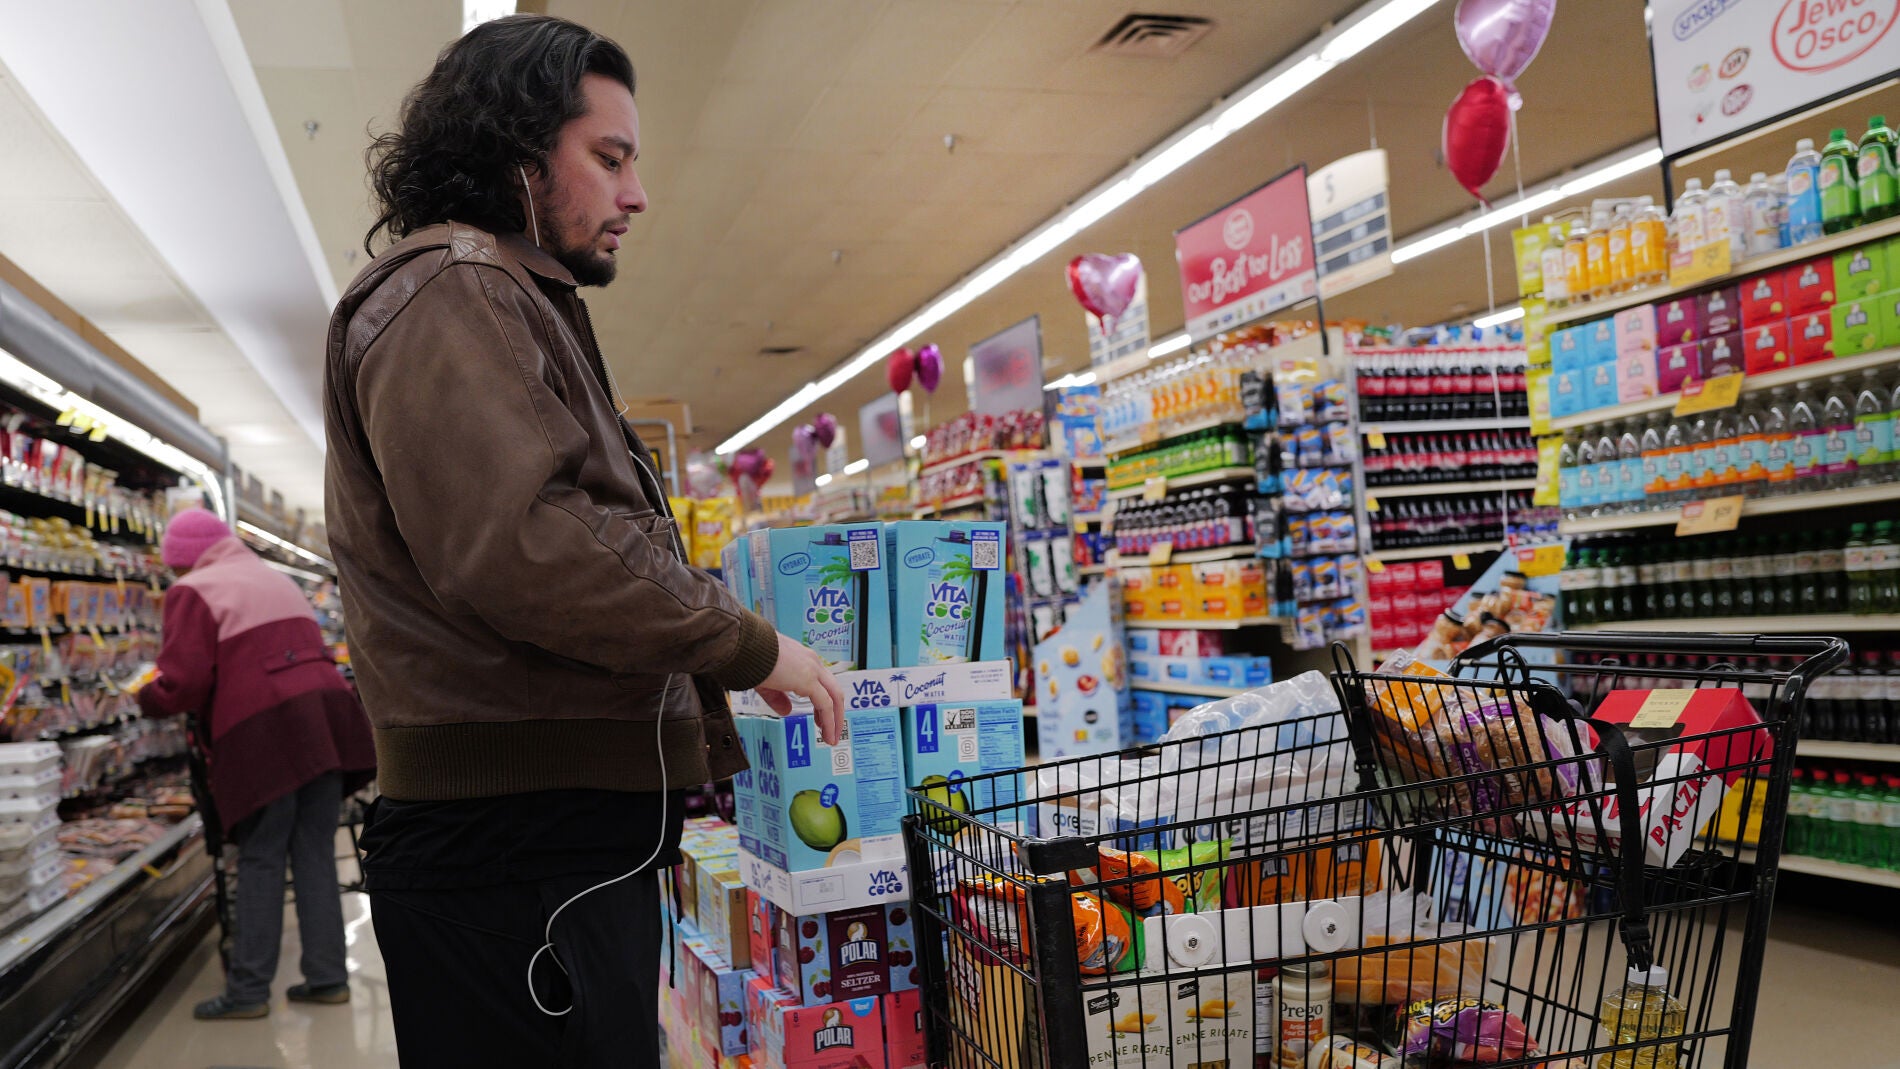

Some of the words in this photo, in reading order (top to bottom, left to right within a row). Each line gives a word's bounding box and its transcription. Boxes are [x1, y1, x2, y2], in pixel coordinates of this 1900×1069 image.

[1795, 11, 1876, 59] Osco
[908, 551, 931, 564] HYDRATE
[809, 586, 850, 607] VITA
[931, 582, 968, 604] VITA
[807, 607, 854, 623] COCO
[926, 602, 972, 619] COCO
[808, 623, 849, 645] Coconut
[926, 620, 966, 637] Coconut
[827, 638, 849, 646] WATER
[853, 679, 886, 696] VITA
[905, 672, 947, 699] Coconut
[923, 690, 945, 698] WATER
[851, 694, 891, 708] COCO
[920, 710, 934, 742] 4
[791, 723, 805, 757] 4
[1053, 813, 1079, 828] core
[869, 870, 898, 885] VITA
[868, 882, 903, 896] COCO
[841, 941, 878, 965] POLAR
[841, 974, 881, 988] SELTZER
[816, 1027, 852, 1050] POLAR
[1090, 1045, 1128, 1065] PENNE
